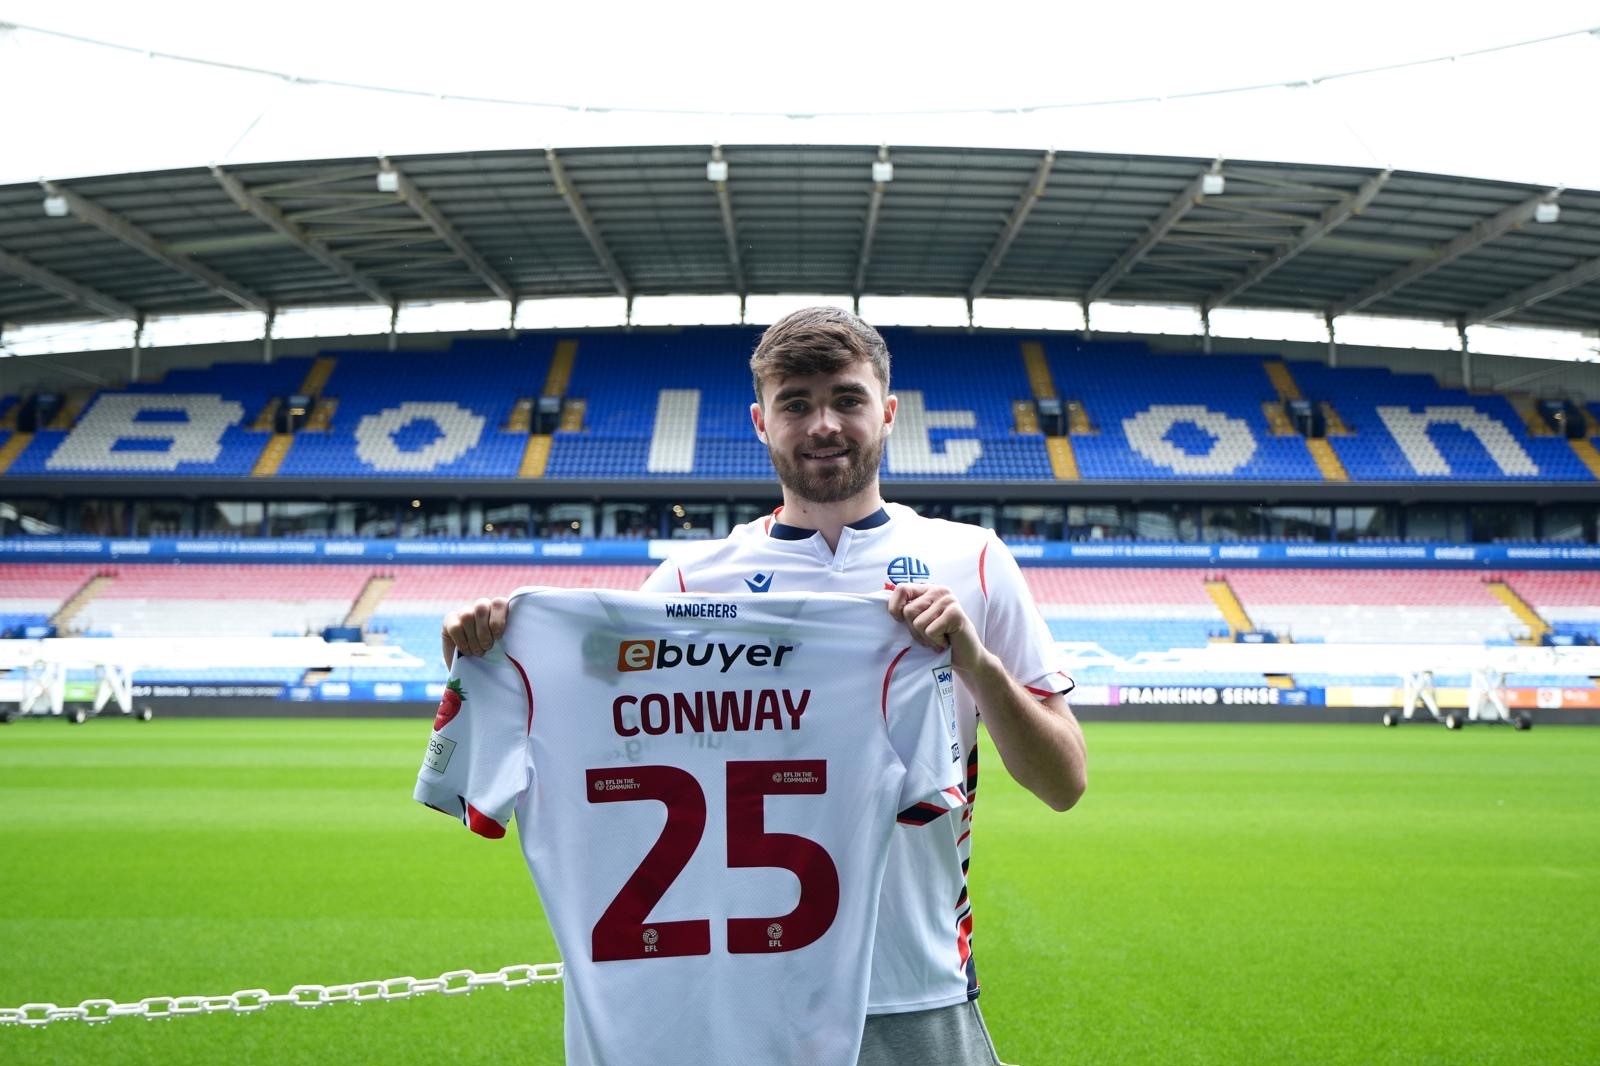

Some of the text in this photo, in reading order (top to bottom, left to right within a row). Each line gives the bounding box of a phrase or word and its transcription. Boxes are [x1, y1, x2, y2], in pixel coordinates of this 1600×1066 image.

[46, 388, 1539, 477] Bolton
[666, 603, 738, 619] WANDERERS
[624, 639, 794, 673] ebuyer
[1119, 687, 1218, 705] FRANKING
[1221, 687, 1279, 705] SENSE
[612, 689, 811, 738] CONWAY
[585, 759, 840, 962] 25
[644, 944, 658, 953] EFL
[768, 939, 782, 948] EFL
